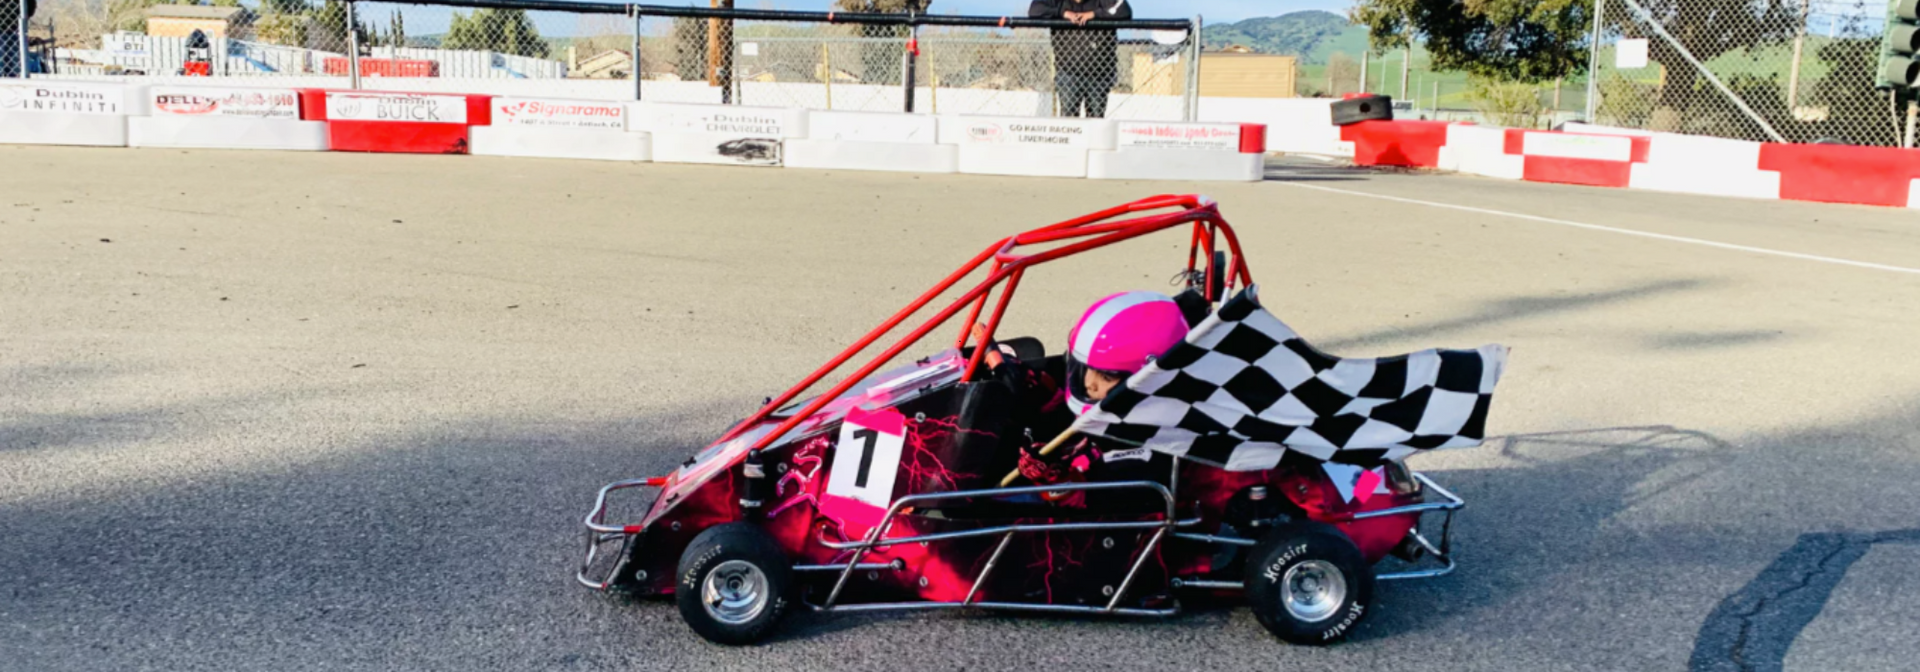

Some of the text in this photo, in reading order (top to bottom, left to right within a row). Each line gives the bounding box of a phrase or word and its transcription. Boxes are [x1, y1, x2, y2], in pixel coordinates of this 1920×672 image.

[36, 89, 104, 100] Dublin
[23, 99, 116, 112] INFINITI
[377, 104, 439, 121] BUICK
[528, 101, 621, 117] Signarama
[714, 114, 776, 124] Dublin
[706, 123, 781, 134] CHEVROLET
[1009, 124, 1082, 135] GO KART RACING
[1018, 134, 1070, 145] LIVERMORE
[853, 428, 879, 488] 1
[682, 544, 722, 589] Hoosier
[1263, 543, 1308, 584] Hoosier
[1323, 601, 1364, 640] Hoosier
